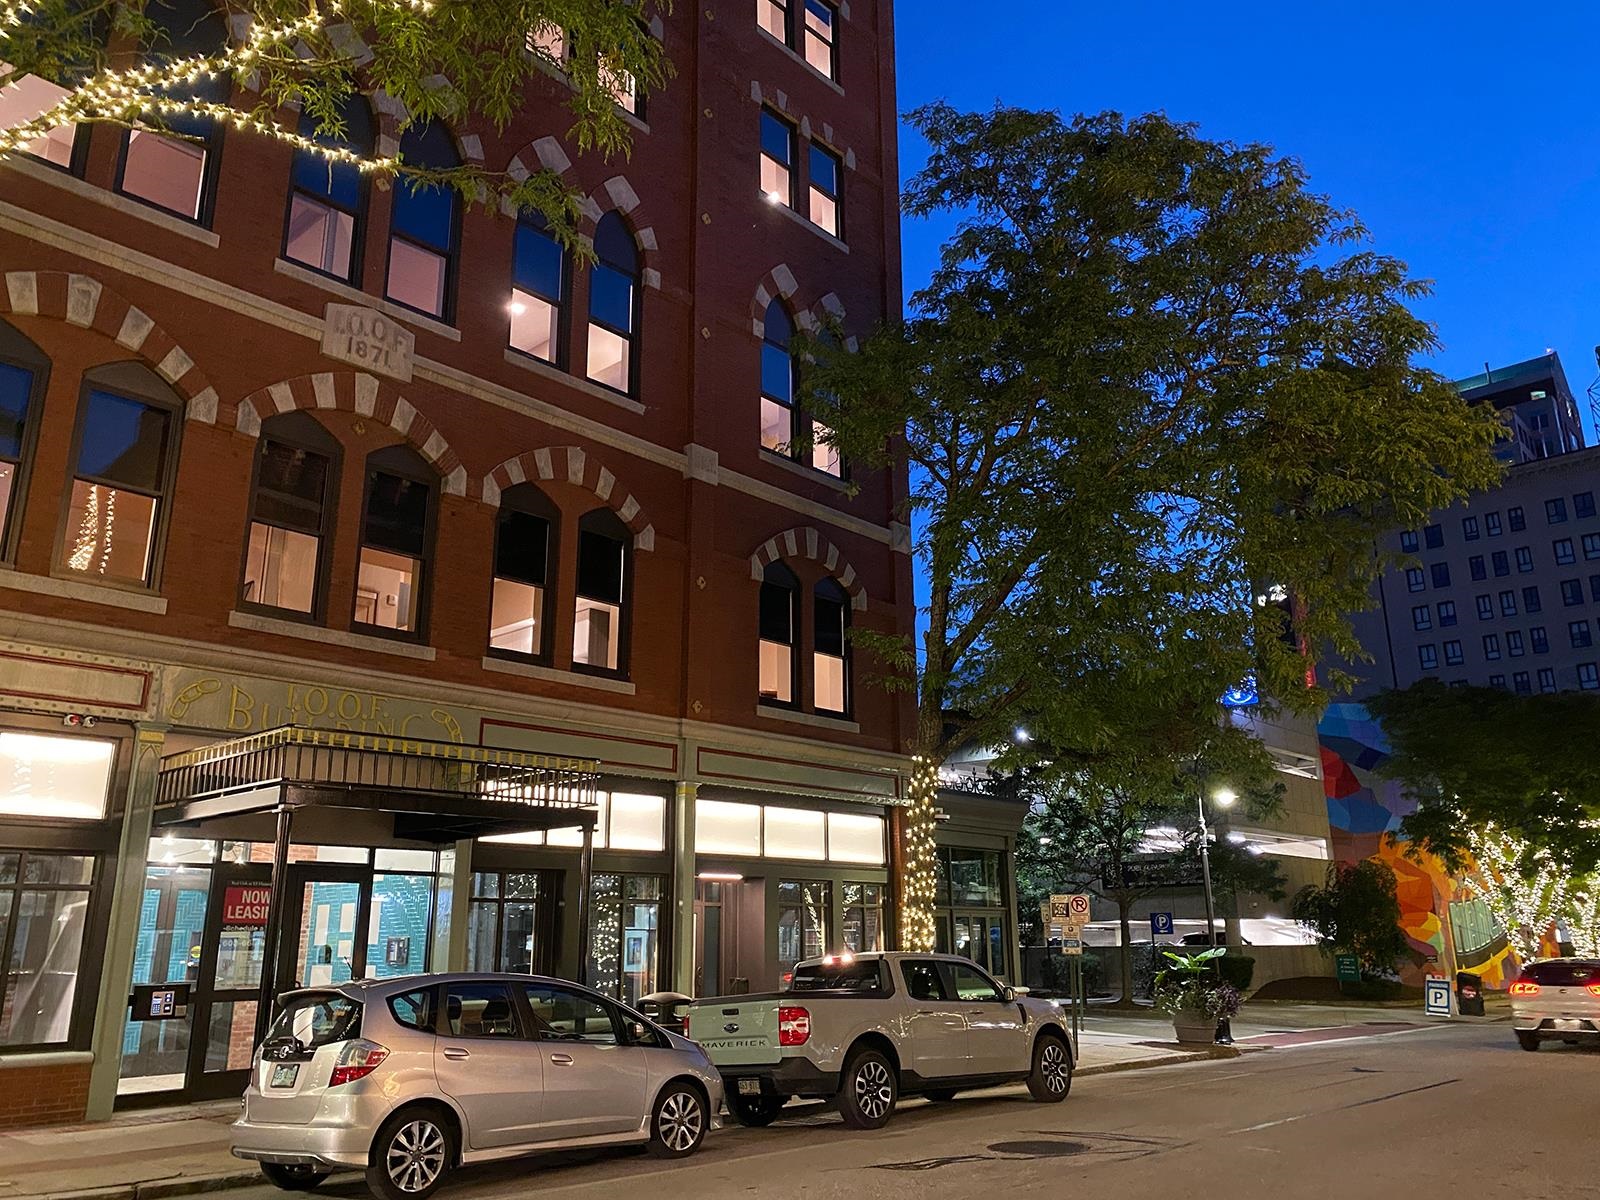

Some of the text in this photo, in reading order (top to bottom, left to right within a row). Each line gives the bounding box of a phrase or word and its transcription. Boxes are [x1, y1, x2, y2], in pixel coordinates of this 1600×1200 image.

[286, 684, 390, 720] I.O.O.F.
[242, 890, 271, 904] NOW
[1434, 991, 1443, 1004] P
[702, 1039, 766, 1049] MAVERICK
